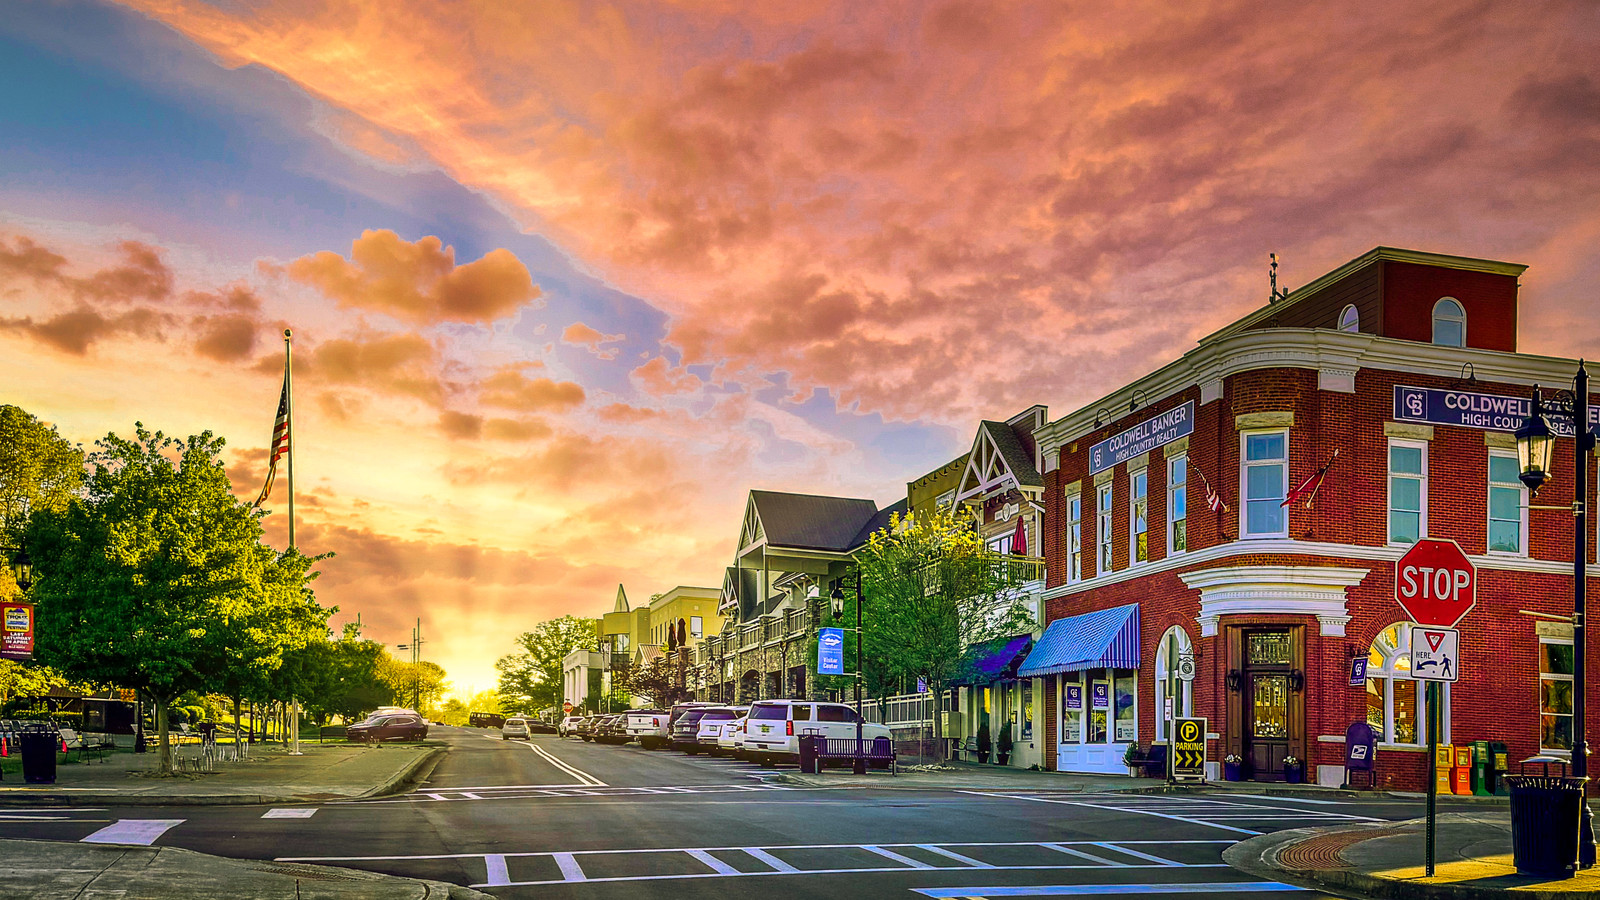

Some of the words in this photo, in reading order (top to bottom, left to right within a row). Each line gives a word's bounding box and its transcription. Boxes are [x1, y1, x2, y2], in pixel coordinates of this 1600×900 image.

[1445, 393, 1532, 417] COLDWELL
[1461, 412, 1491, 426] HIGH
[1109, 423, 1150, 453] COLDWELL
[1152, 407, 1186, 435] BANKER
[1115, 449, 1129, 462] HIGH
[1129, 437, 1156, 456] COUNTRY
[1156, 426, 1178, 445] REALTY
[1401, 565, 1470, 601] STOP
[1415, 651, 1431, 660] HERE
[1185, 725, 1195, 738] P
[1175, 742, 1204, 751] PARKING
